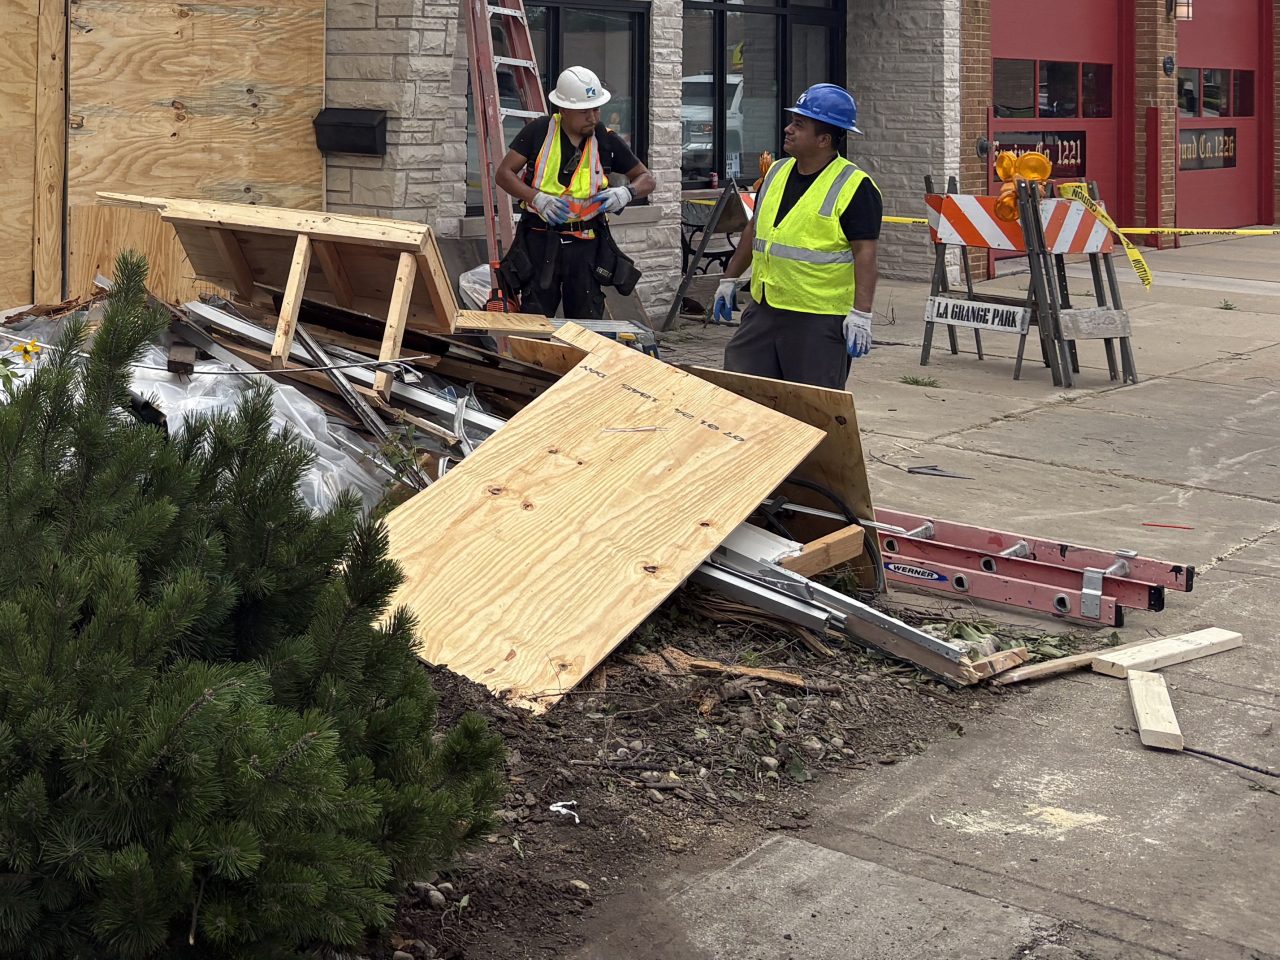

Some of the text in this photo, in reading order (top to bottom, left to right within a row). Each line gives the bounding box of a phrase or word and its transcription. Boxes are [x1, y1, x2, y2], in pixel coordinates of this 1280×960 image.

[1057, 139, 1081, 165] 1221
[1215, 136, 1234, 157] 1226
[1071, 188, 1097, 213] CAUTION
[935, 301, 1019, 328] LA GRANGE PARK
[579, 364, 607, 379] DAY
[893, 564, 935, 579] WERNER
